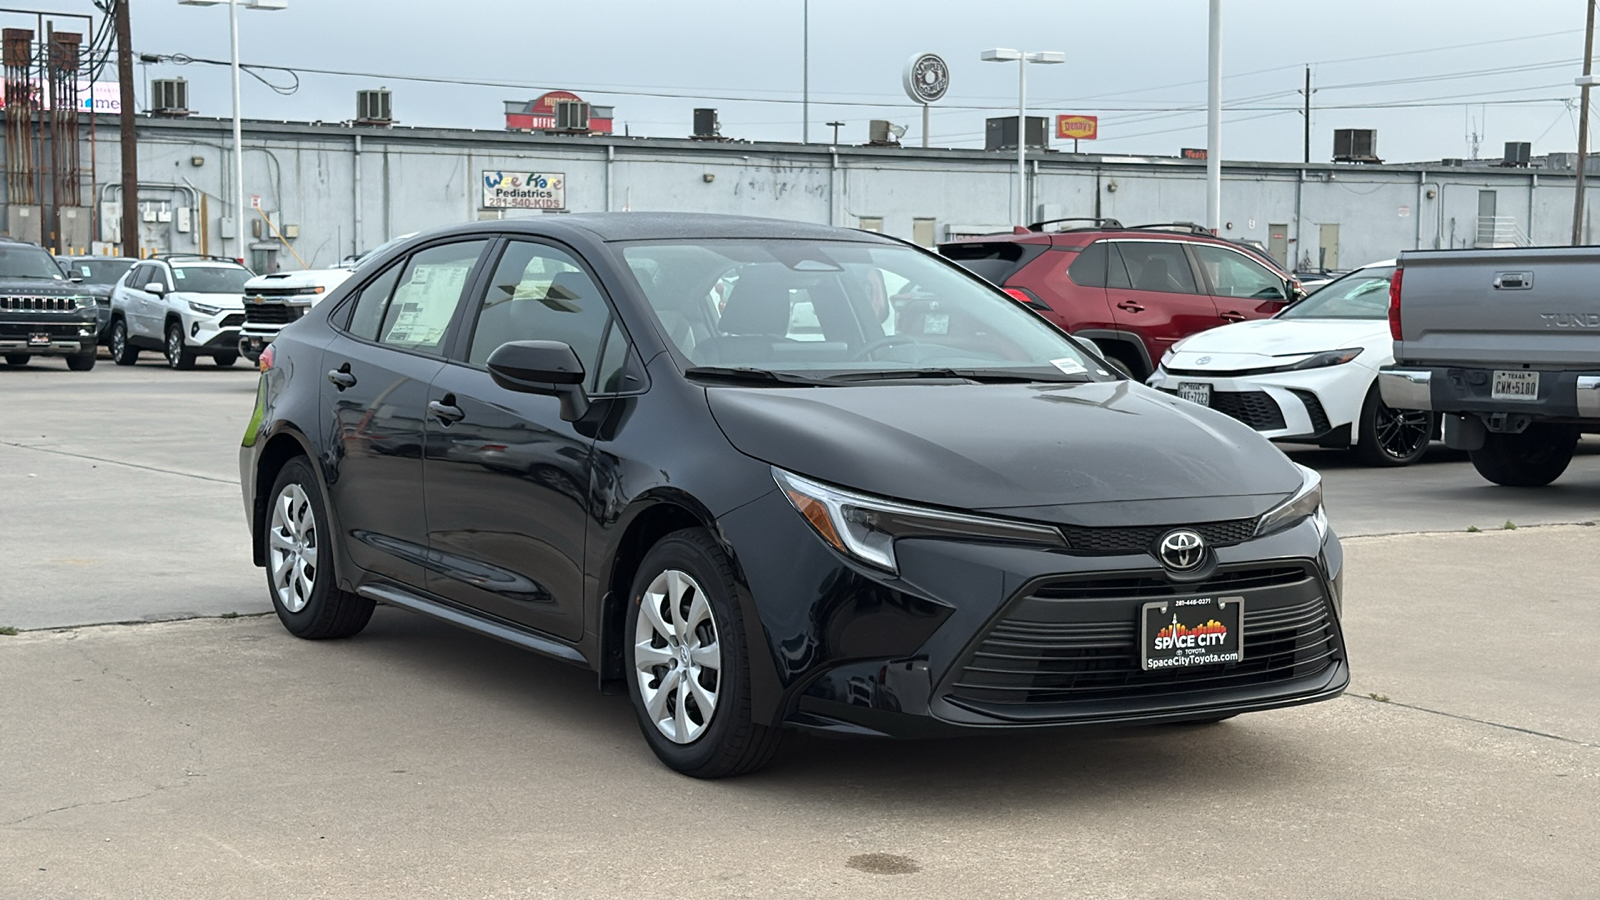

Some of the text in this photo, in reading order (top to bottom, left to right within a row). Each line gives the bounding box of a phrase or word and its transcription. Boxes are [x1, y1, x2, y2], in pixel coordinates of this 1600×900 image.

[533, 117, 556, 129] OFFIC
[485, 171, 562, 190] Wee Kare
[496, 189, 553, 198] Pediatrics
[489, 198, 560, 208] 281-540-KIDS
[1154, 632, 1227, 650] SPACE CITY
[1147, 652, 1238, 670] SpaceCityToyota.com
